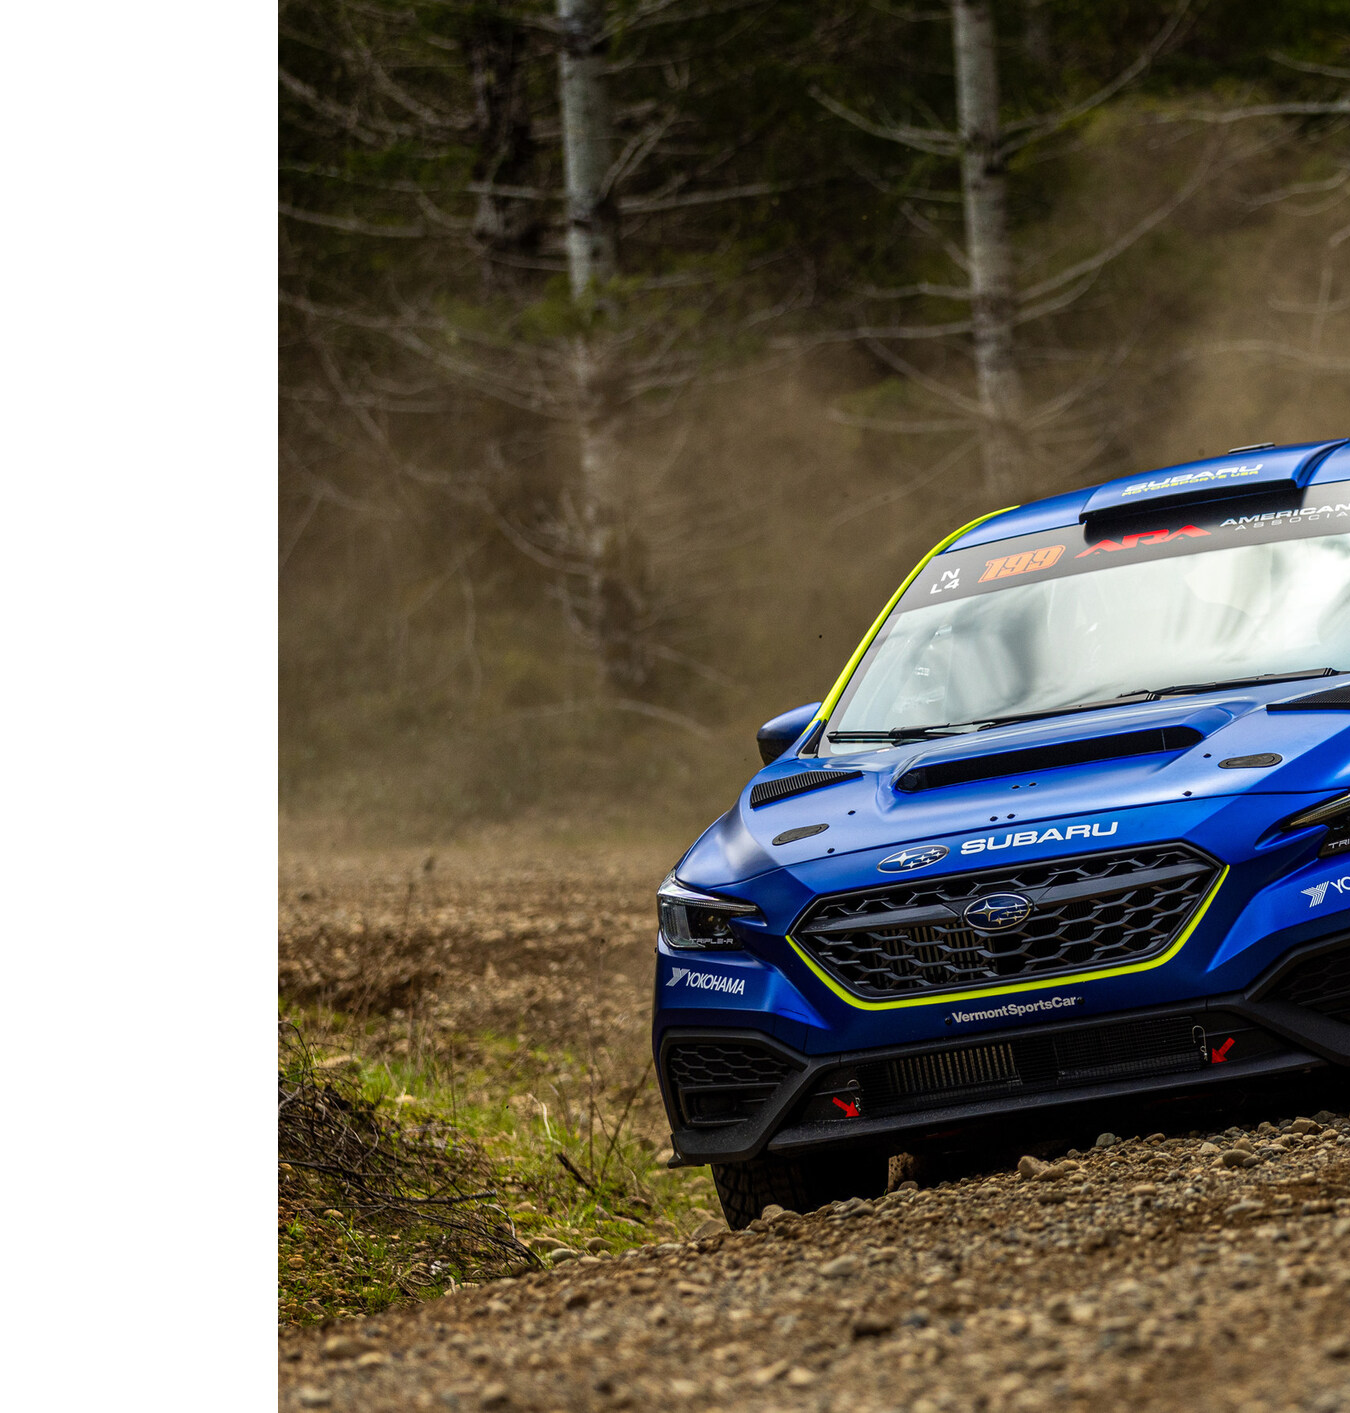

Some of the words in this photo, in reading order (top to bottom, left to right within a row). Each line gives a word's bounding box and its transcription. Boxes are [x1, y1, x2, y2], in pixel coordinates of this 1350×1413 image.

[1124, 464, 1263, 492] SUBARU
[1074, 525, 1211, 558] ARA
[941, 568, 960, 581] N
[978, 545, 1066, 583] 199
[930, 579, 960, 594] L4
[960, 822, 1118, 854] SUBARU
[686, 971, 745, 995] YOKOHAMA
[952, 996, 1077, 1023] VermontSportsCar
